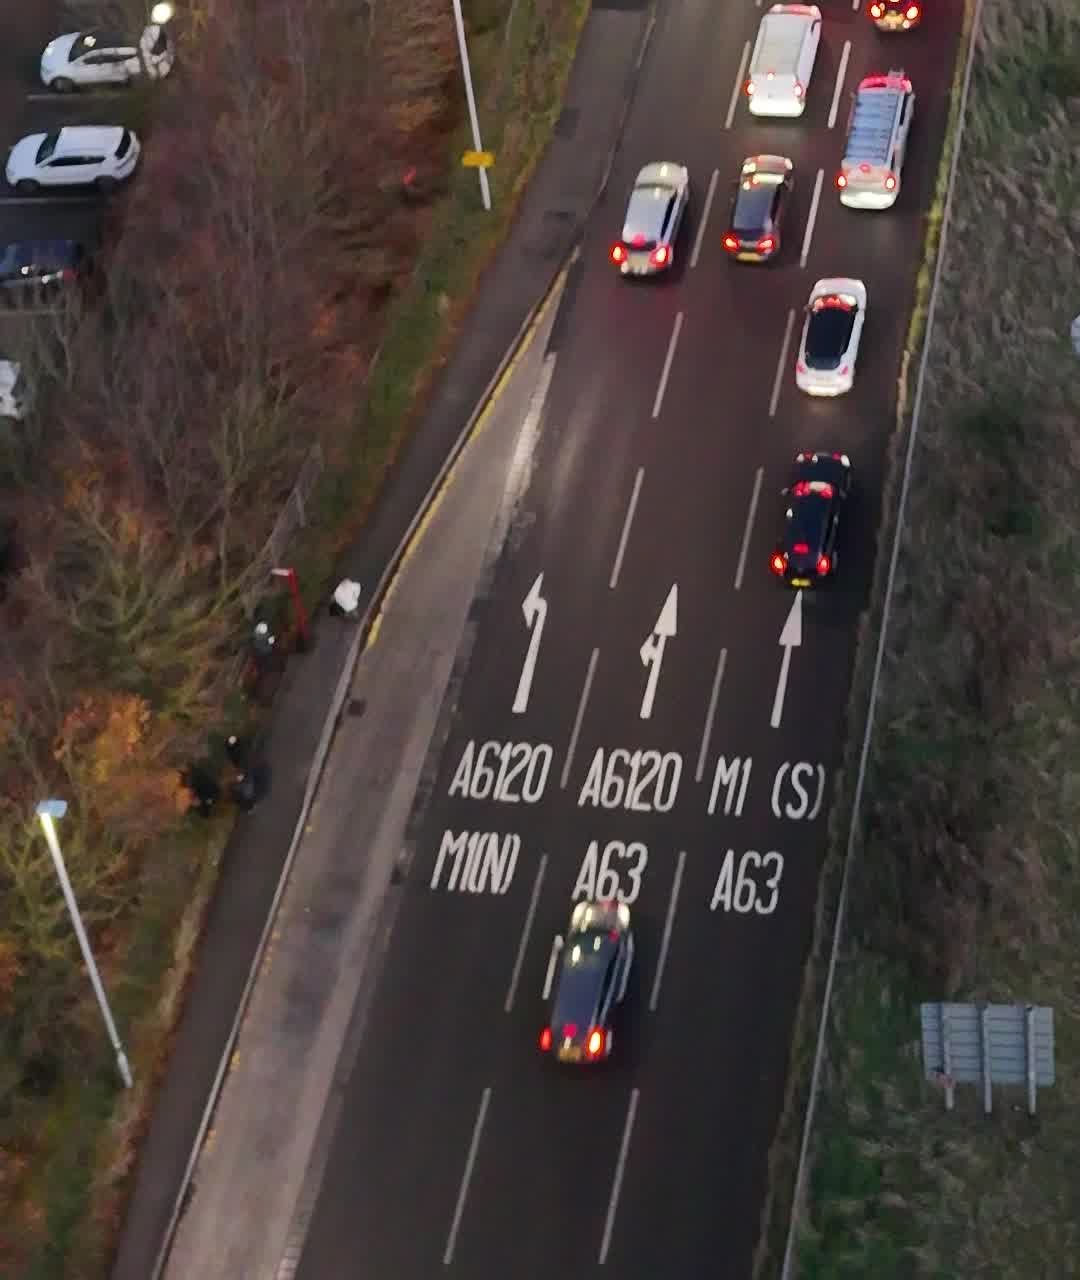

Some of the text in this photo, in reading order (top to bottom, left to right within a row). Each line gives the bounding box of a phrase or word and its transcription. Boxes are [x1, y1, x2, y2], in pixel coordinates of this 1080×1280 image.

[448, 739, 554, 804] A6120
[577, 746, 683, 813] A6120
[707, 755, 826, 820] M1 (S)
[430, 829, 522, 895] M1(N)
[571, 839, 649, 905] A63
[709, 848, 785, 915] A63
